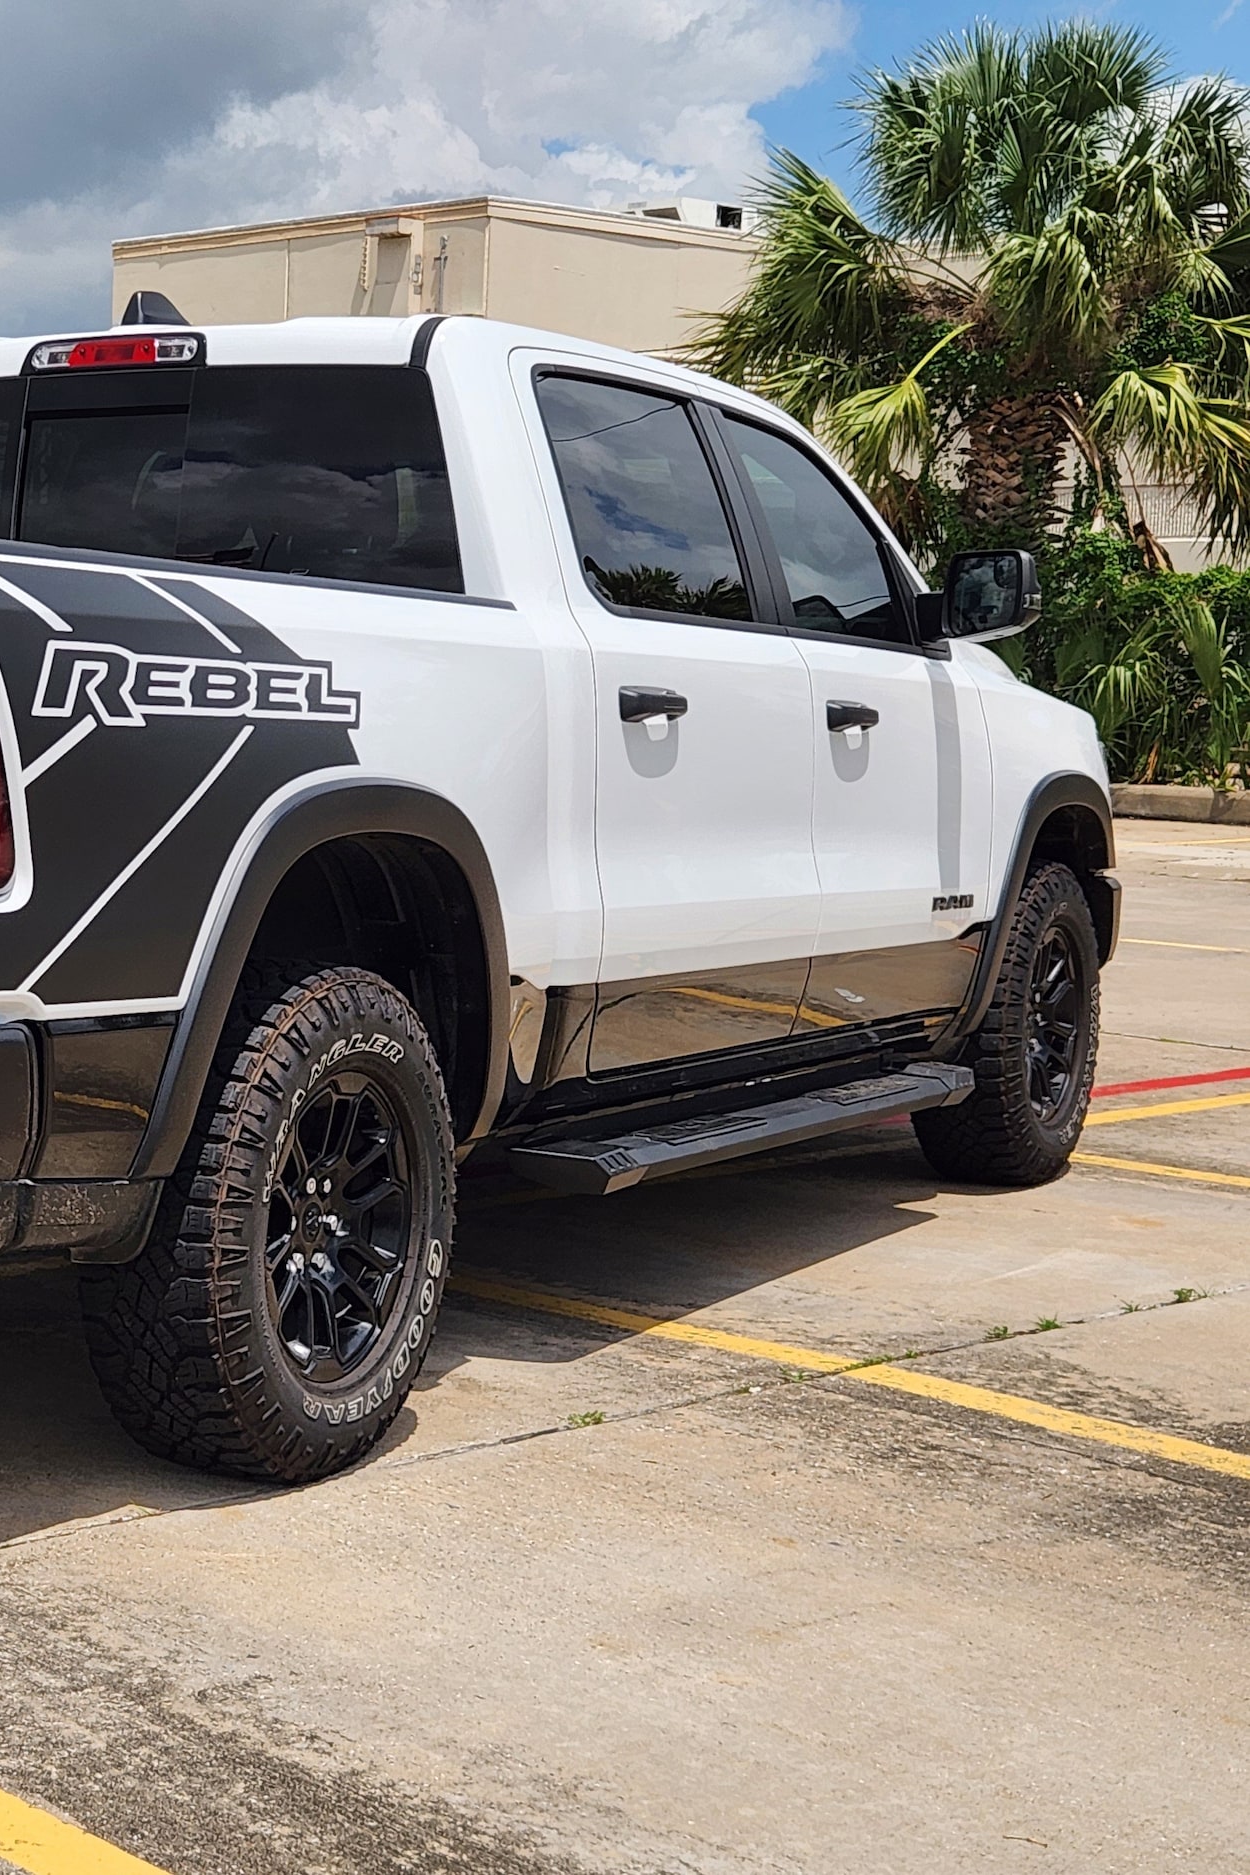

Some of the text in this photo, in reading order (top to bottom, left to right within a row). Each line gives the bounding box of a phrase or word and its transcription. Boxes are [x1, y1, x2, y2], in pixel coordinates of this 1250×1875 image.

[30, 639, 358, 728] REBEL
[931, 894, 974, 912] RAM
[262, 1032, 406, 1204] WRANGLER
[301, 1237, 445, 1426] GOODYEAR
